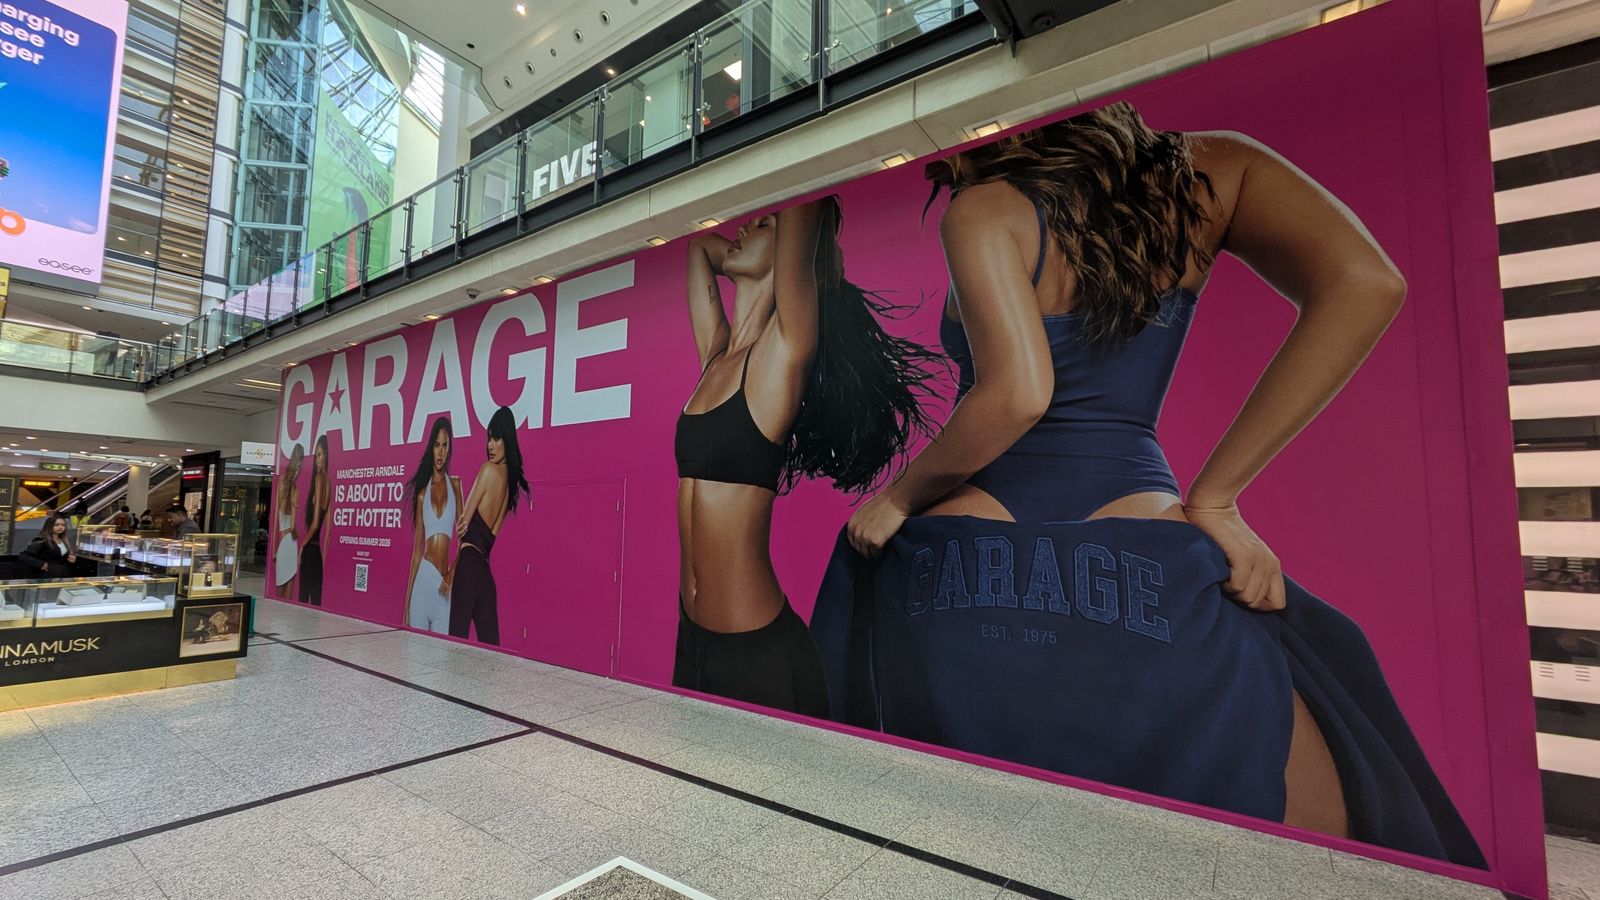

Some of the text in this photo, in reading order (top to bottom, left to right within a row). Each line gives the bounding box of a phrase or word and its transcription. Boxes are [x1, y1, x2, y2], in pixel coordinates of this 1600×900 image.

[0, 2, 80, 47] arging
[0, 39, 45, 66] ger
[532, 140, 597, 200] FIVE
[38, 257, 91, 275] easee
[279, 259, 635, 460] GARAGE
[336, 465, 405, 479] MANCHESTER ARNDALE
[335, 482, 404, 503] IS ABOUT TO
[333, 508, 402, 528] GET HOTTER
[339, 535, 359, 545] OPENING
[359, 537, 379, 546] SUMMER
[905, 536, 1172, 644] GARAGE
[981, 624, 1057, 645] EST. 1975
[4, 656, 55, 667] LONDON
